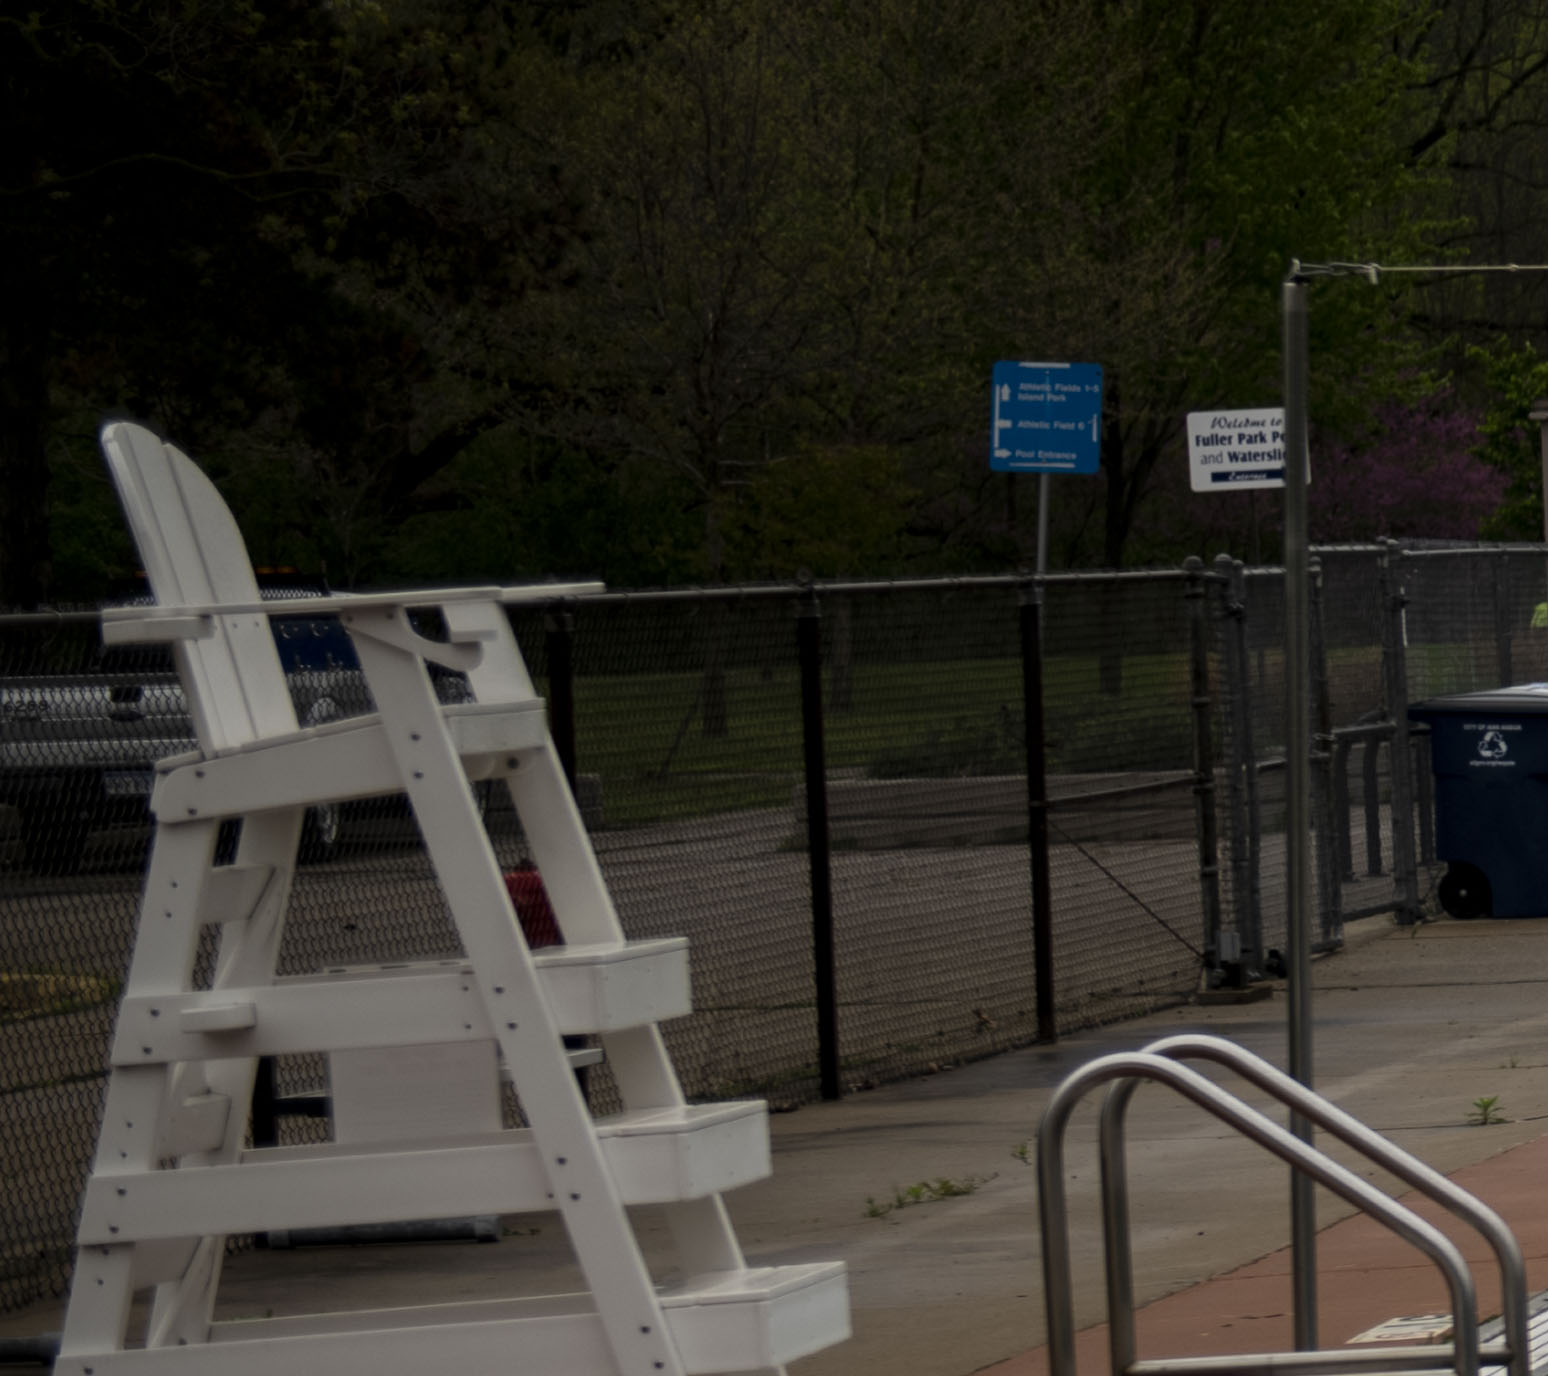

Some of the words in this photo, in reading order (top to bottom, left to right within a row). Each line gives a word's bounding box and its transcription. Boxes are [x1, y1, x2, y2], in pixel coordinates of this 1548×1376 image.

[1019, 382, 1052, 393] Athletic
[1054, 384, 1082, 393] Fields
[1017, 393, 1045, 402] Island
[1046, 392, 1067, 403] Park
[1016, 419, 1051, 430] Athletic
[1053, 420, 1076, 431] Field
[1210, 416, 1267, 430] Welcome
[1271, 417, 1283, 427] to
[1195, 433, 1233, 447] Fuller
[1238, 431, 1268, 445] Park
[1272, 431, 1286, 443] Po
[1014, 448, 1036, 459] Pool
[1037, 449, 1078, 461] Entrance
[1200, 451, 1224, 466] and
[1227, 448, 1287, 464] Watersli
